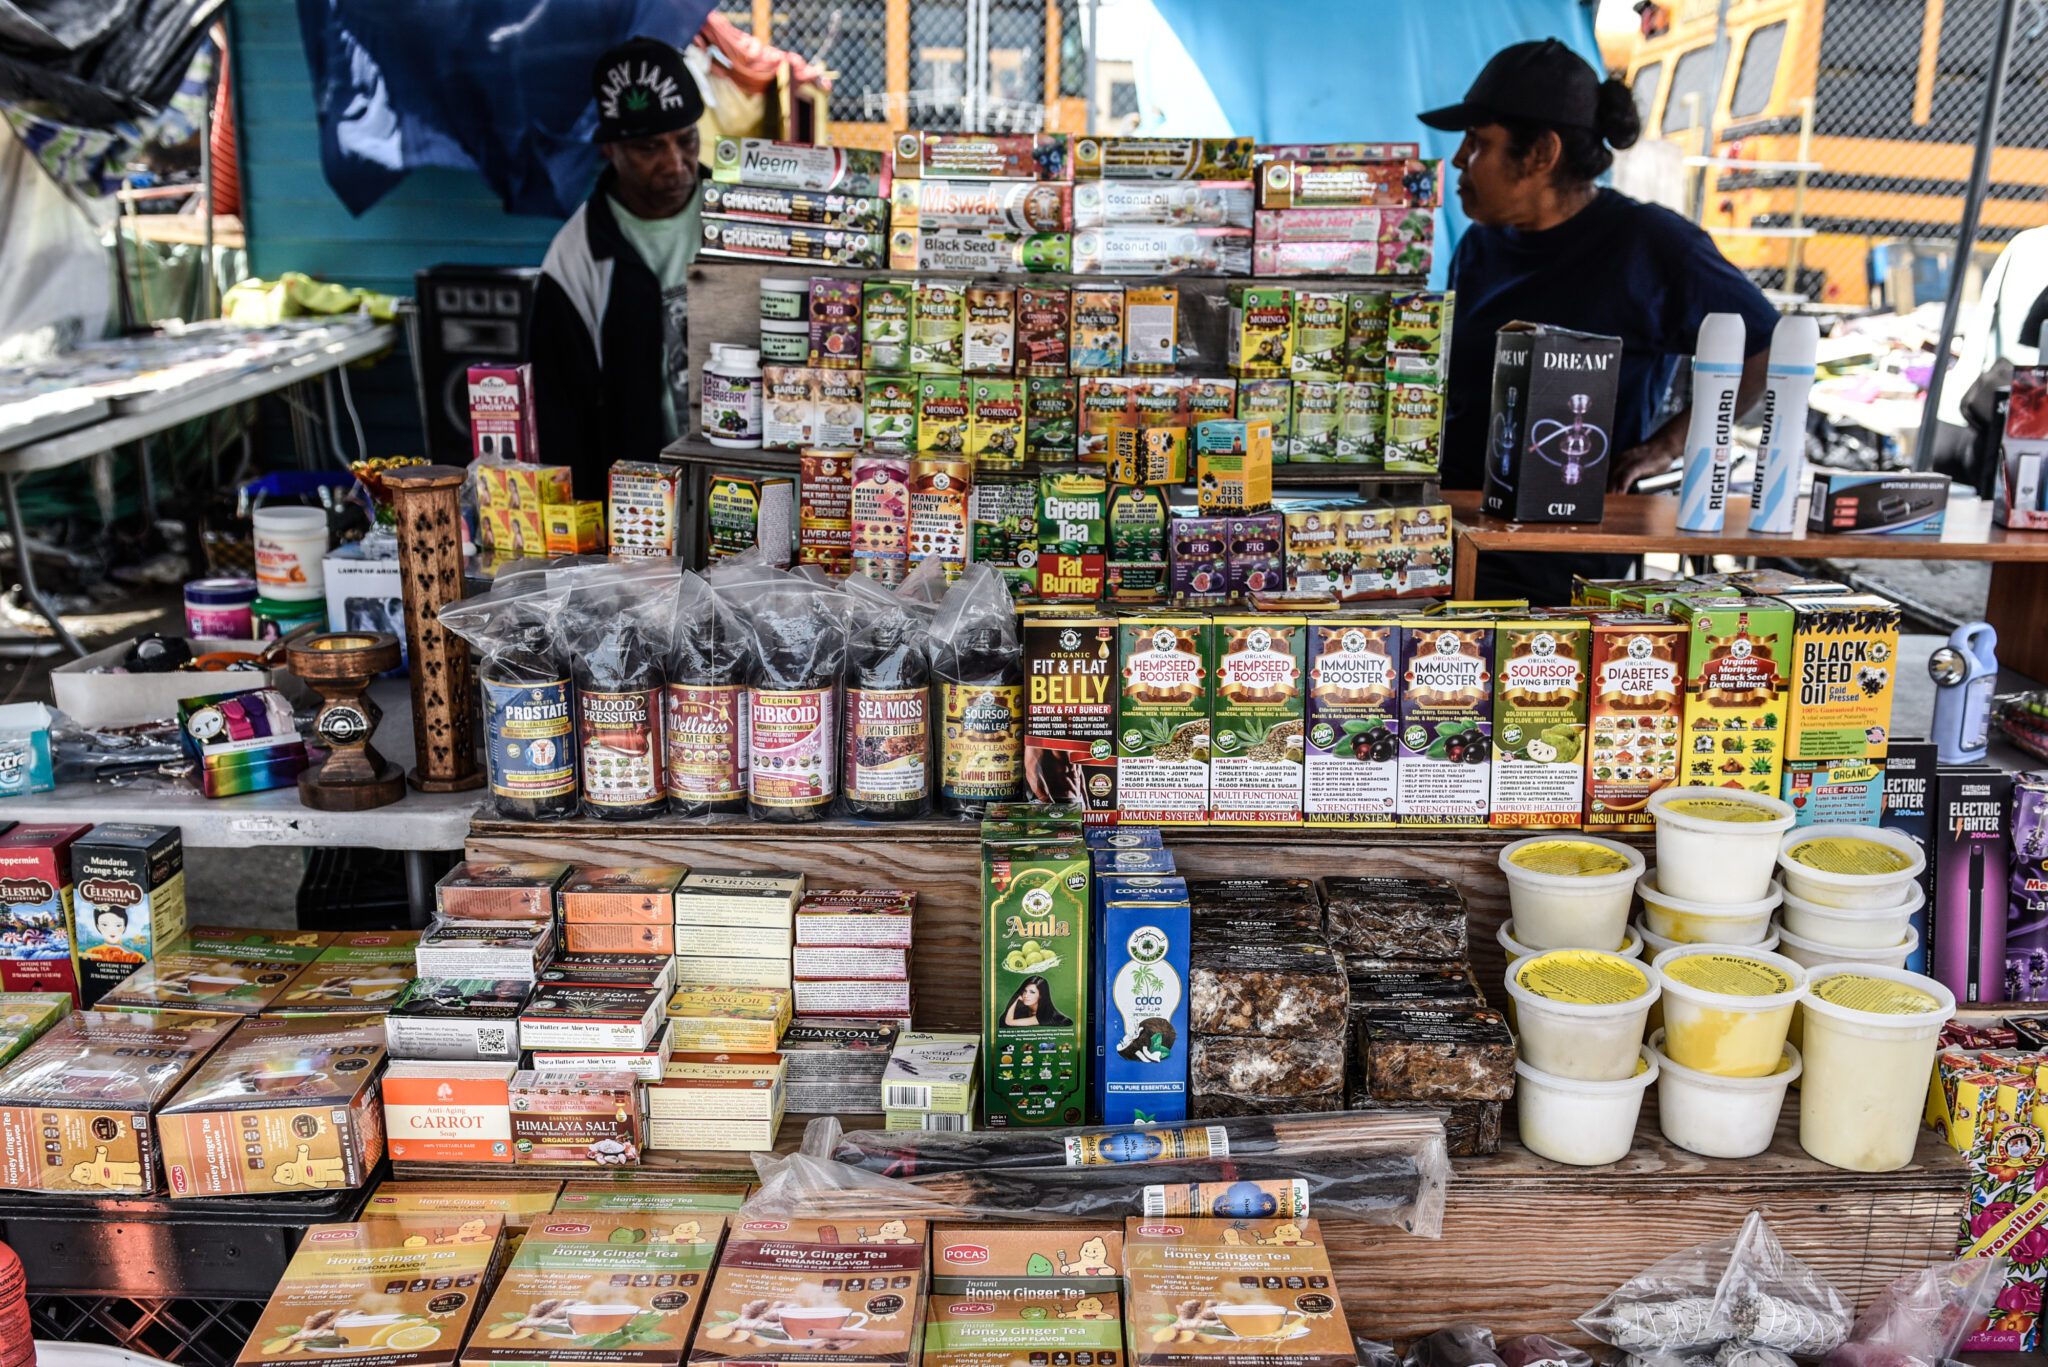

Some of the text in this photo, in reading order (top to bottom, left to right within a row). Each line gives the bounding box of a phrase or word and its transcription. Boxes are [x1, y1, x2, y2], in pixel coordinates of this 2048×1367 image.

[602, 61, 683, 118] MARY JANE
[745, 152, 798, 175] Neem
[722, 192, 792, 214] CHARCOAL
[922, 186, 999, 215] Miswak
[1108, 195, 1169, 205] Coconut Oil
[722, 229, 792, 251] CHARCOAL
[925, 238, 995, 251] Black Seed
[826, 305, 843, 315] FIG
[921, 305, 954, 314] NEEM
[1250, 315, 1286, 324] MORINGA
[1304, 313, 1336, 323] NEEM
[1543, 353, 1608, 371] DREAM
[773, 385, 805, 394] GARLIC
[871, 399, 912, 408] Bitter Melon
[1398, 403, 1432, 413] NEEM
[926, 406, 964, 415] MORINGA
[1710, 390, 1734, 510] RIGHT GUARD
[911, 494, 948, 503] MANUKA
[1046, 497, 1100, 519] Green
[1548, 504, 1576, 516] CUP
[1056, 520, 1088, 542] Tea
[1292, 532, 1334, 540] Ashwagandha
[1403, 526, 1444, 536] Ashwagandha
[611, 547, 667, 556] DIABETIC CARE
[1191, 544, 1209, 552] FIG
[1059, 557, 1082, 576] Fat
[1043, 574, 1099, 593] Burner
[1804, 642, 1866, 663] BLACK
[1033, 660, 1107, 674] FIT & FLAT
[1134, 661, 1196, 671] HEMPSEED
[1321, 660, 1385, 671] IMMUNITY
[1140, 672, 1189, 681] BOOSTER
[1512, 666, 1575, 677] SOURSOP
[1609, 669, 1669, 680] DIABETES
[1802, 663, 1851, 683] SEED
[1323, 673, 1383, 683] BOOSTER
[1031, 676, 1109, 704] BELLY
[1621, 681, 1653, 691] CARE
[1801, 684, 1826, 705] Oil
[1829, 693, 1859, 702] Pressed
[591, 700, 634, 711] BLOOD
[859, 700, 922, 718] SEA MOSS
[1033, 706, 1055, 714] DETOX
[1079, 706, 1108, 714] BURNER
[506, 702, 568, 720] PROSTATE
[584, 710, 646, 722] PRESSURE
[753, 707, 818, 722] FIBROID
[965, 709, 1009, 719] SOURSOP
[670, 715, 728, 733] Wellness
[862, 724, 919, 736] LIVING BITTER
[1833, 769, 1872, 780] ORGANIC
[953, 787, 1015, 796] RESPIRATORY
[1120, 790, 1205, 799] MULTI FUNCTIONAL
[1817, 786, 1867, 794] FREE-FROM
[1949, 803, 2001, 817] ELECTRIC
[1120, 811, 1204, 820] IMMUNE SYSTEM
[1309, 813, 1391, 822] IMMUNE SYSTEM
[1495, 815, 1577, 824] RESPIRATORY
[91, 858, 127, 866] Mandarin
[84, 867, 134, 876] Orange Spice
[700, 878, 779, 887] MORINGA
[83, 884, 137, 899] CELESTIAL
[814, 896, 898, 904] STRAWBERRY
[1002, 916, 1070, 938] Amla
[1136, 997, 1162, 1005] COCO
[1401, 1010, 1453, 1018] AFRICAN
[790, 1029, 879, 1039] CHARCOAL
[427, 1107, 466, 1115] Anti-Aging
[410, 1117, 484, 1129] CARROT
[516, 1121, 618, 1131] HIMALAYA SALT
[440, 1130, 456, 1138] Soap
[208, 1137, 218, 1165] Ginger
[178, 1168, 189, 1192] POCAS
[212, 1168, 222, 1191] Honey
[546, 1225, 589, 1233] POCAS
[312, 1231, 357, 1241] POCAS
[326, 1250, 456, 1266] Honey Ginger Tea
[552, 1248, 678, 1258] Honey Ginger Tea
[760, 1248, 887, 1260] Honey Ginger Tea
[946, 1251, 987, 1259] POCAS
[776, 1257, 830, 1265] CINNAMON
[960, 1327, 1006, 1336] Honey
[1016, 1327, 1062, 1335] Ginger
